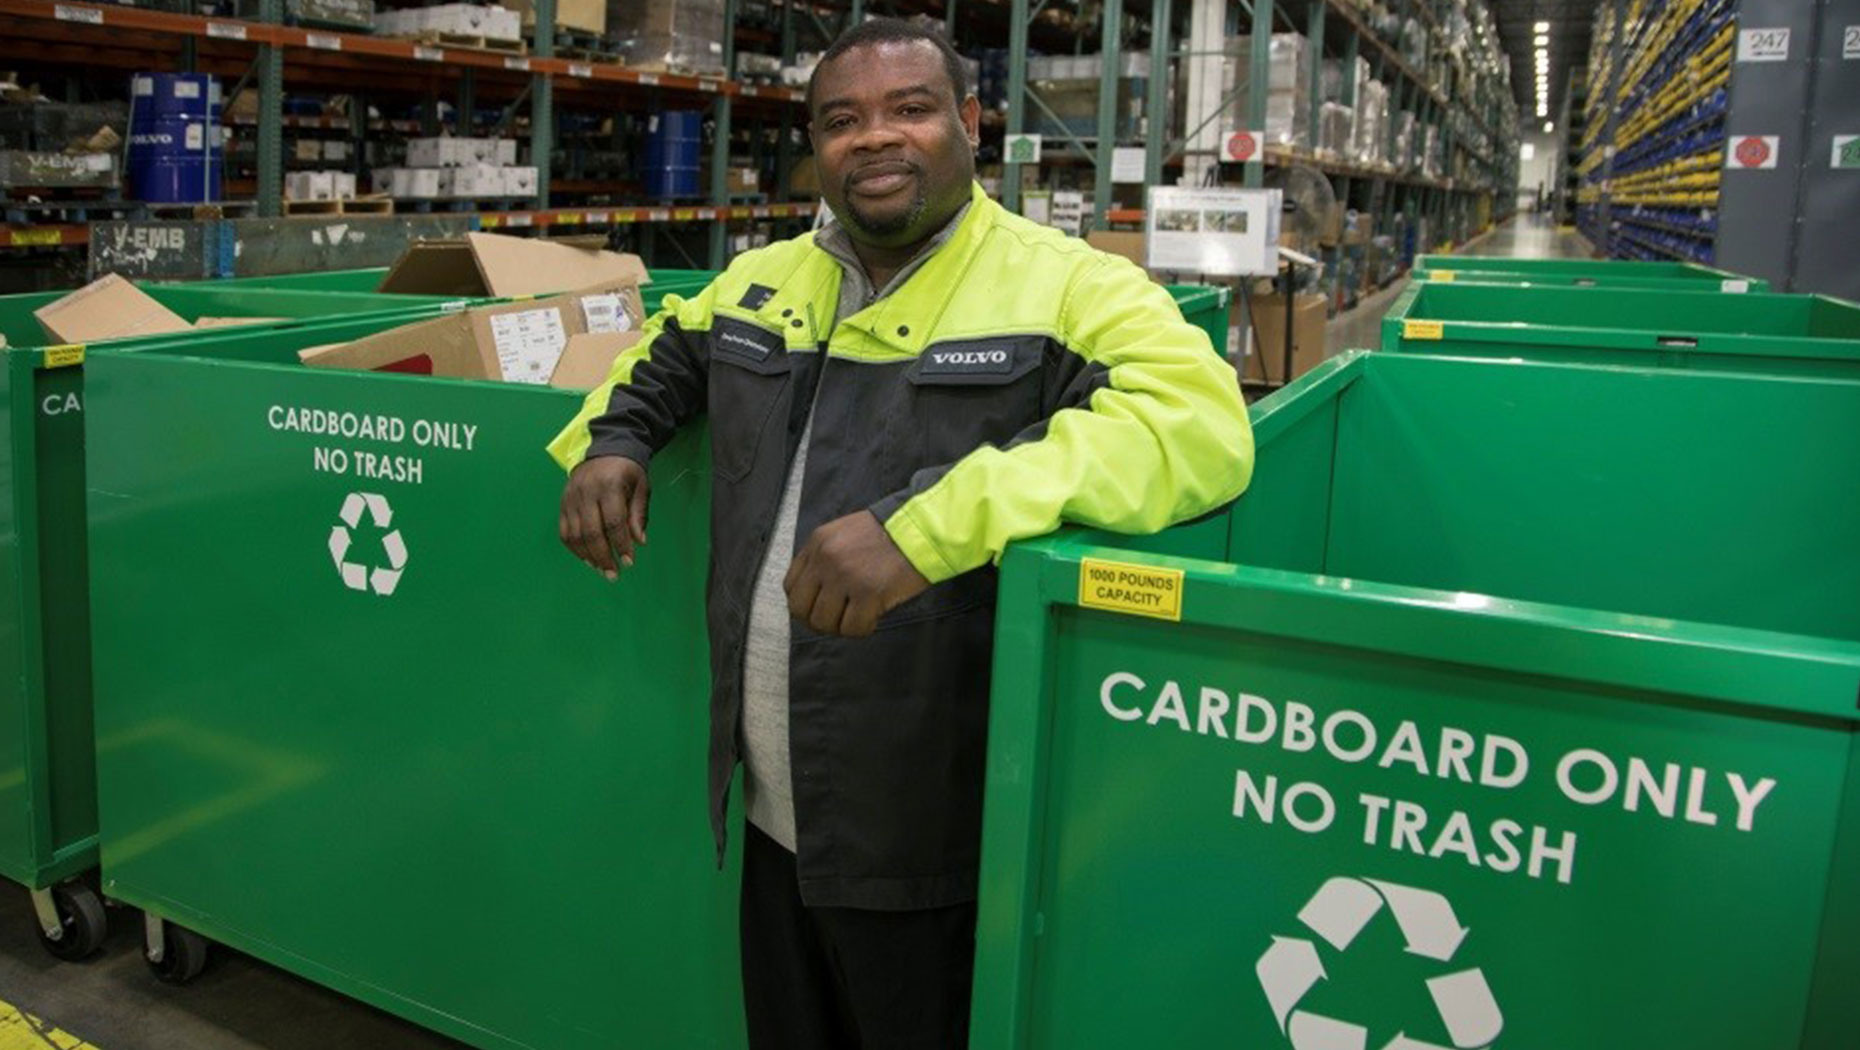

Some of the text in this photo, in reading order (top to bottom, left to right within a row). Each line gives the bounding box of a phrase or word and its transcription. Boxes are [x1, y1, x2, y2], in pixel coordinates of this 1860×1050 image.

[1751, 31, 1788, 49] 247
[112, 224, 185, 250] V-EMB
[932, 350, 1007, 364] VOLVO
[267, 404, 478, 451] CARDBOARD ONLY
[313, 446, 423, 485] NO TRASH
[1089, 569, 1174, 591] 1000 POUNDS
[1096, 587, 1161, 605] CAPACITY
[1099, 671, 1778, 833] CARDBOARD ONLY
[1231, 768, 1578, 885] NO TRASH
